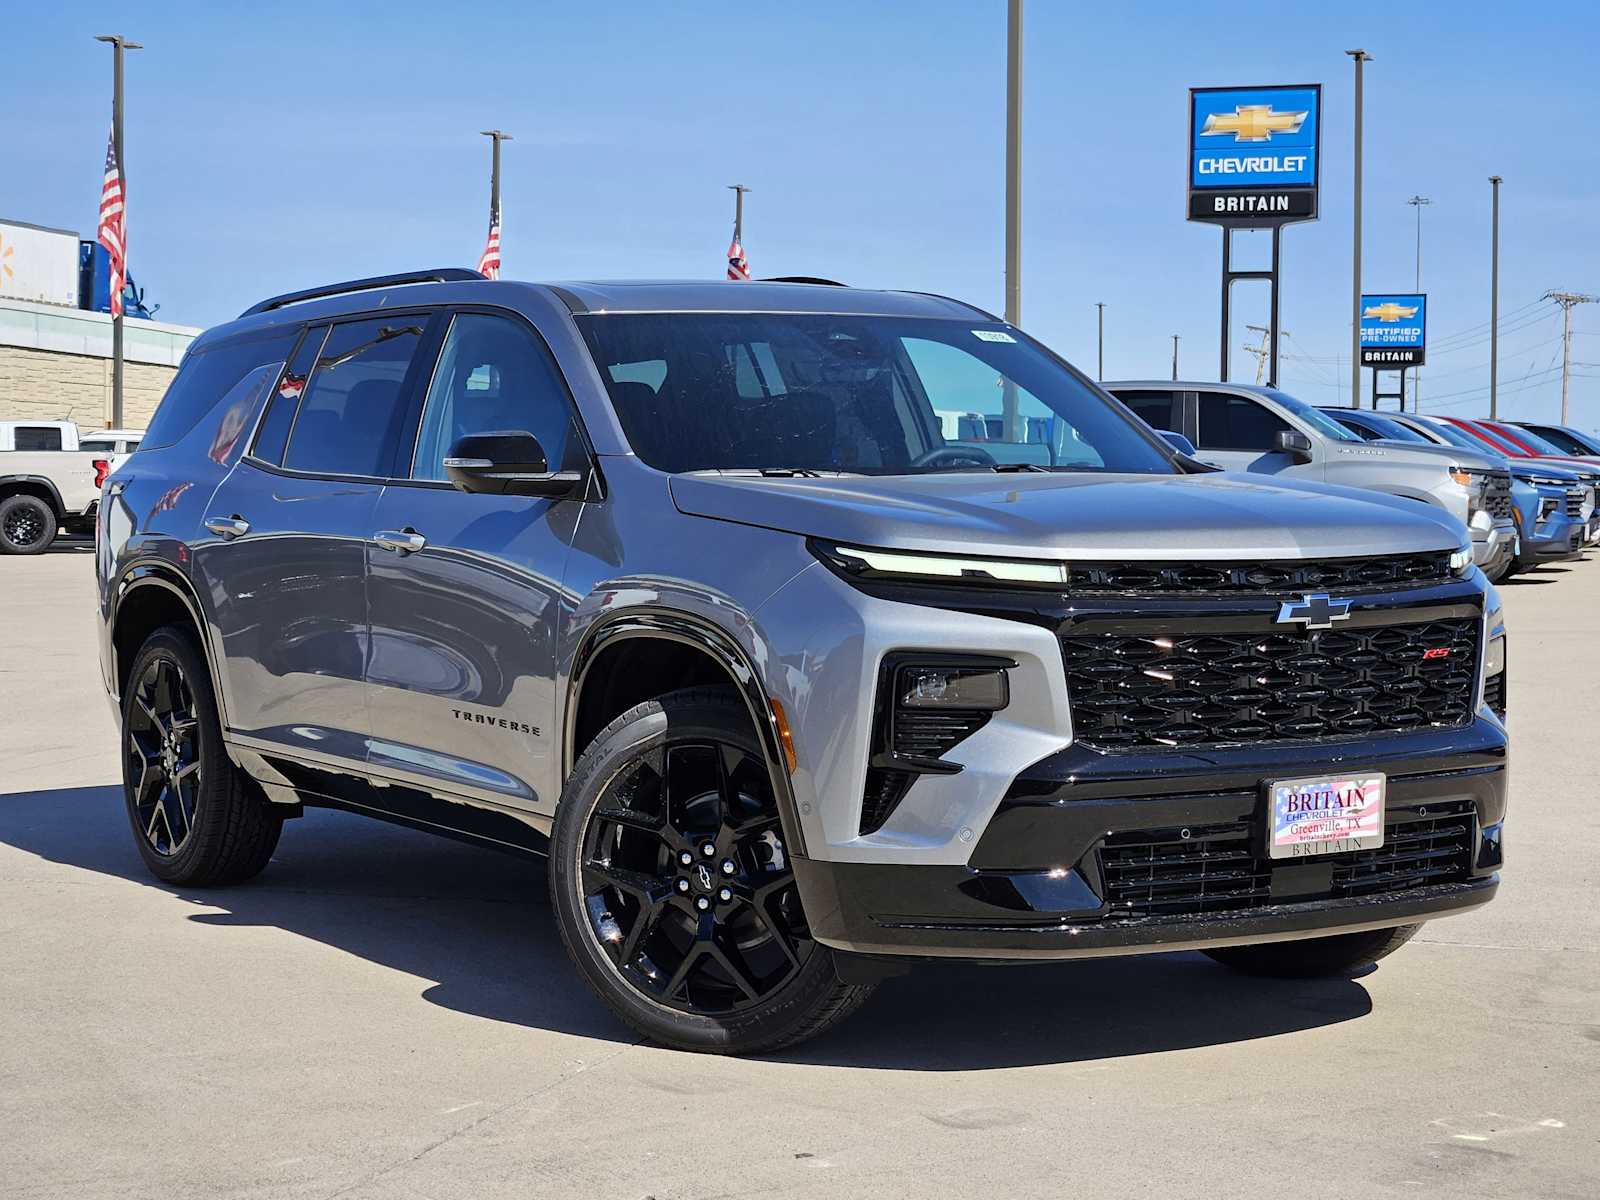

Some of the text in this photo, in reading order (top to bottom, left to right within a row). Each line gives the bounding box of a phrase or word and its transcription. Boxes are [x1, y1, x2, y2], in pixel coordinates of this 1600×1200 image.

[1199, 156, 1307, 174] CHEVROLET
[1214, 195, 1289, 212] BRITAIN
[1360, 327, 1421, 336] CERTIFIED
[1365, 351, 1413, 361] BRITAIN
[1423, 647, 1450, 659] RS
[452, 709, 541, 737] TRAVERSE
[1288, 787, 1366, 812] BRITAIN
[1286, 810, 1343, 821] CHEVROLET
[1290, 817, 1361, 836] Greenville, TX
[1292, 838, 1362, 855] BRITAIN
